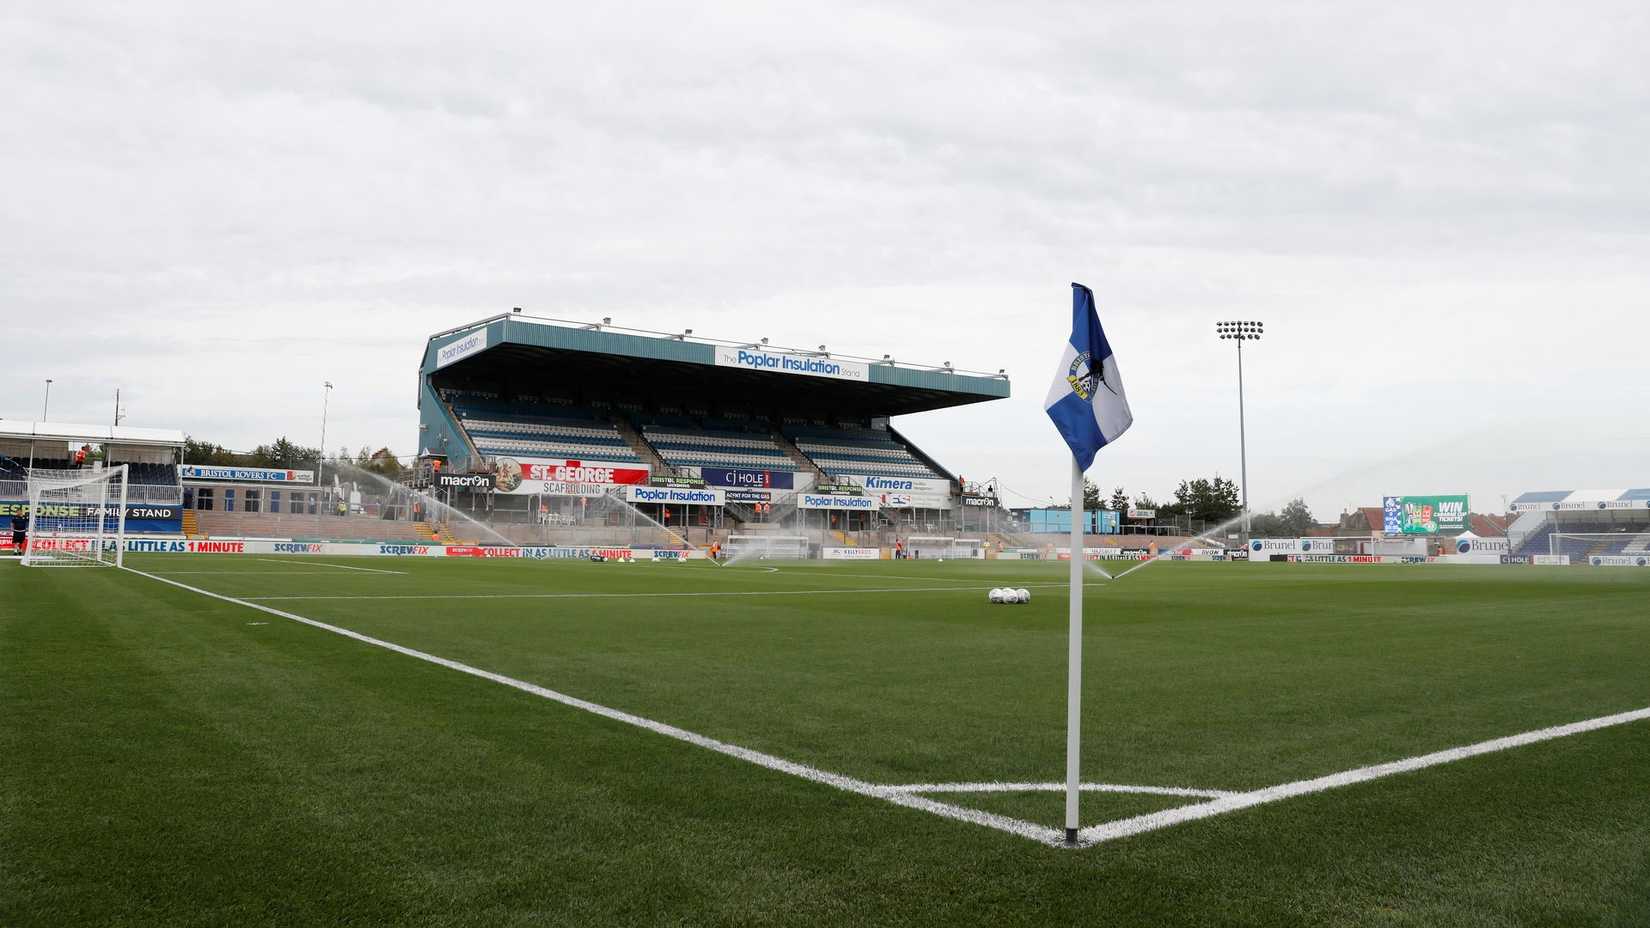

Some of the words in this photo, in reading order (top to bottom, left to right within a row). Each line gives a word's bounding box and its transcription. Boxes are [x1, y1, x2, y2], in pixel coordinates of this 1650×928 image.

[724, 354, 736, 364] The
[738, 350, 780, 368] Poplar
[782, 355, 840, 375] Insulation
[841, 368, 860, 377] Stand
[202, 470, 233, 478] BRISTOL
[235, 471, 264, 480] ROVERS
[530, 465, 552, 481] ST.
[555, 466, 614, 483] GEORGE
[738, 473, 764, 484] HOLE
[865, 476, 913, 489] Kimera
[543, 482, 601, 495] SCAFFOLDING
[635, 488, 669, 501] Poplar
[670, 490, 715, 502] Insulation
[805, 496, 832, 507] Poplar
[833, 497, 872, 508] Insulation
[1439, 502, 1463, 512] WIN
[132, 508, 172, 518] STAND
[128, 541, 166, 551] LITTLE
[168, 542, 185, 551] AS
[188, 543, 195, 552] 1
[198, 542, 244, 553] MINUTE
[274, 543, 322, 554] SCREWFIX
[1263, 540, 1296, 550] Brunel
[484, 548, 520, 558] COLLECT
[523, 549, 532, 558] IN
[536, 549, 547, 558] AS
[578, 549, 590, 558] AS
[599, 550, 633, 559] MINUTE
